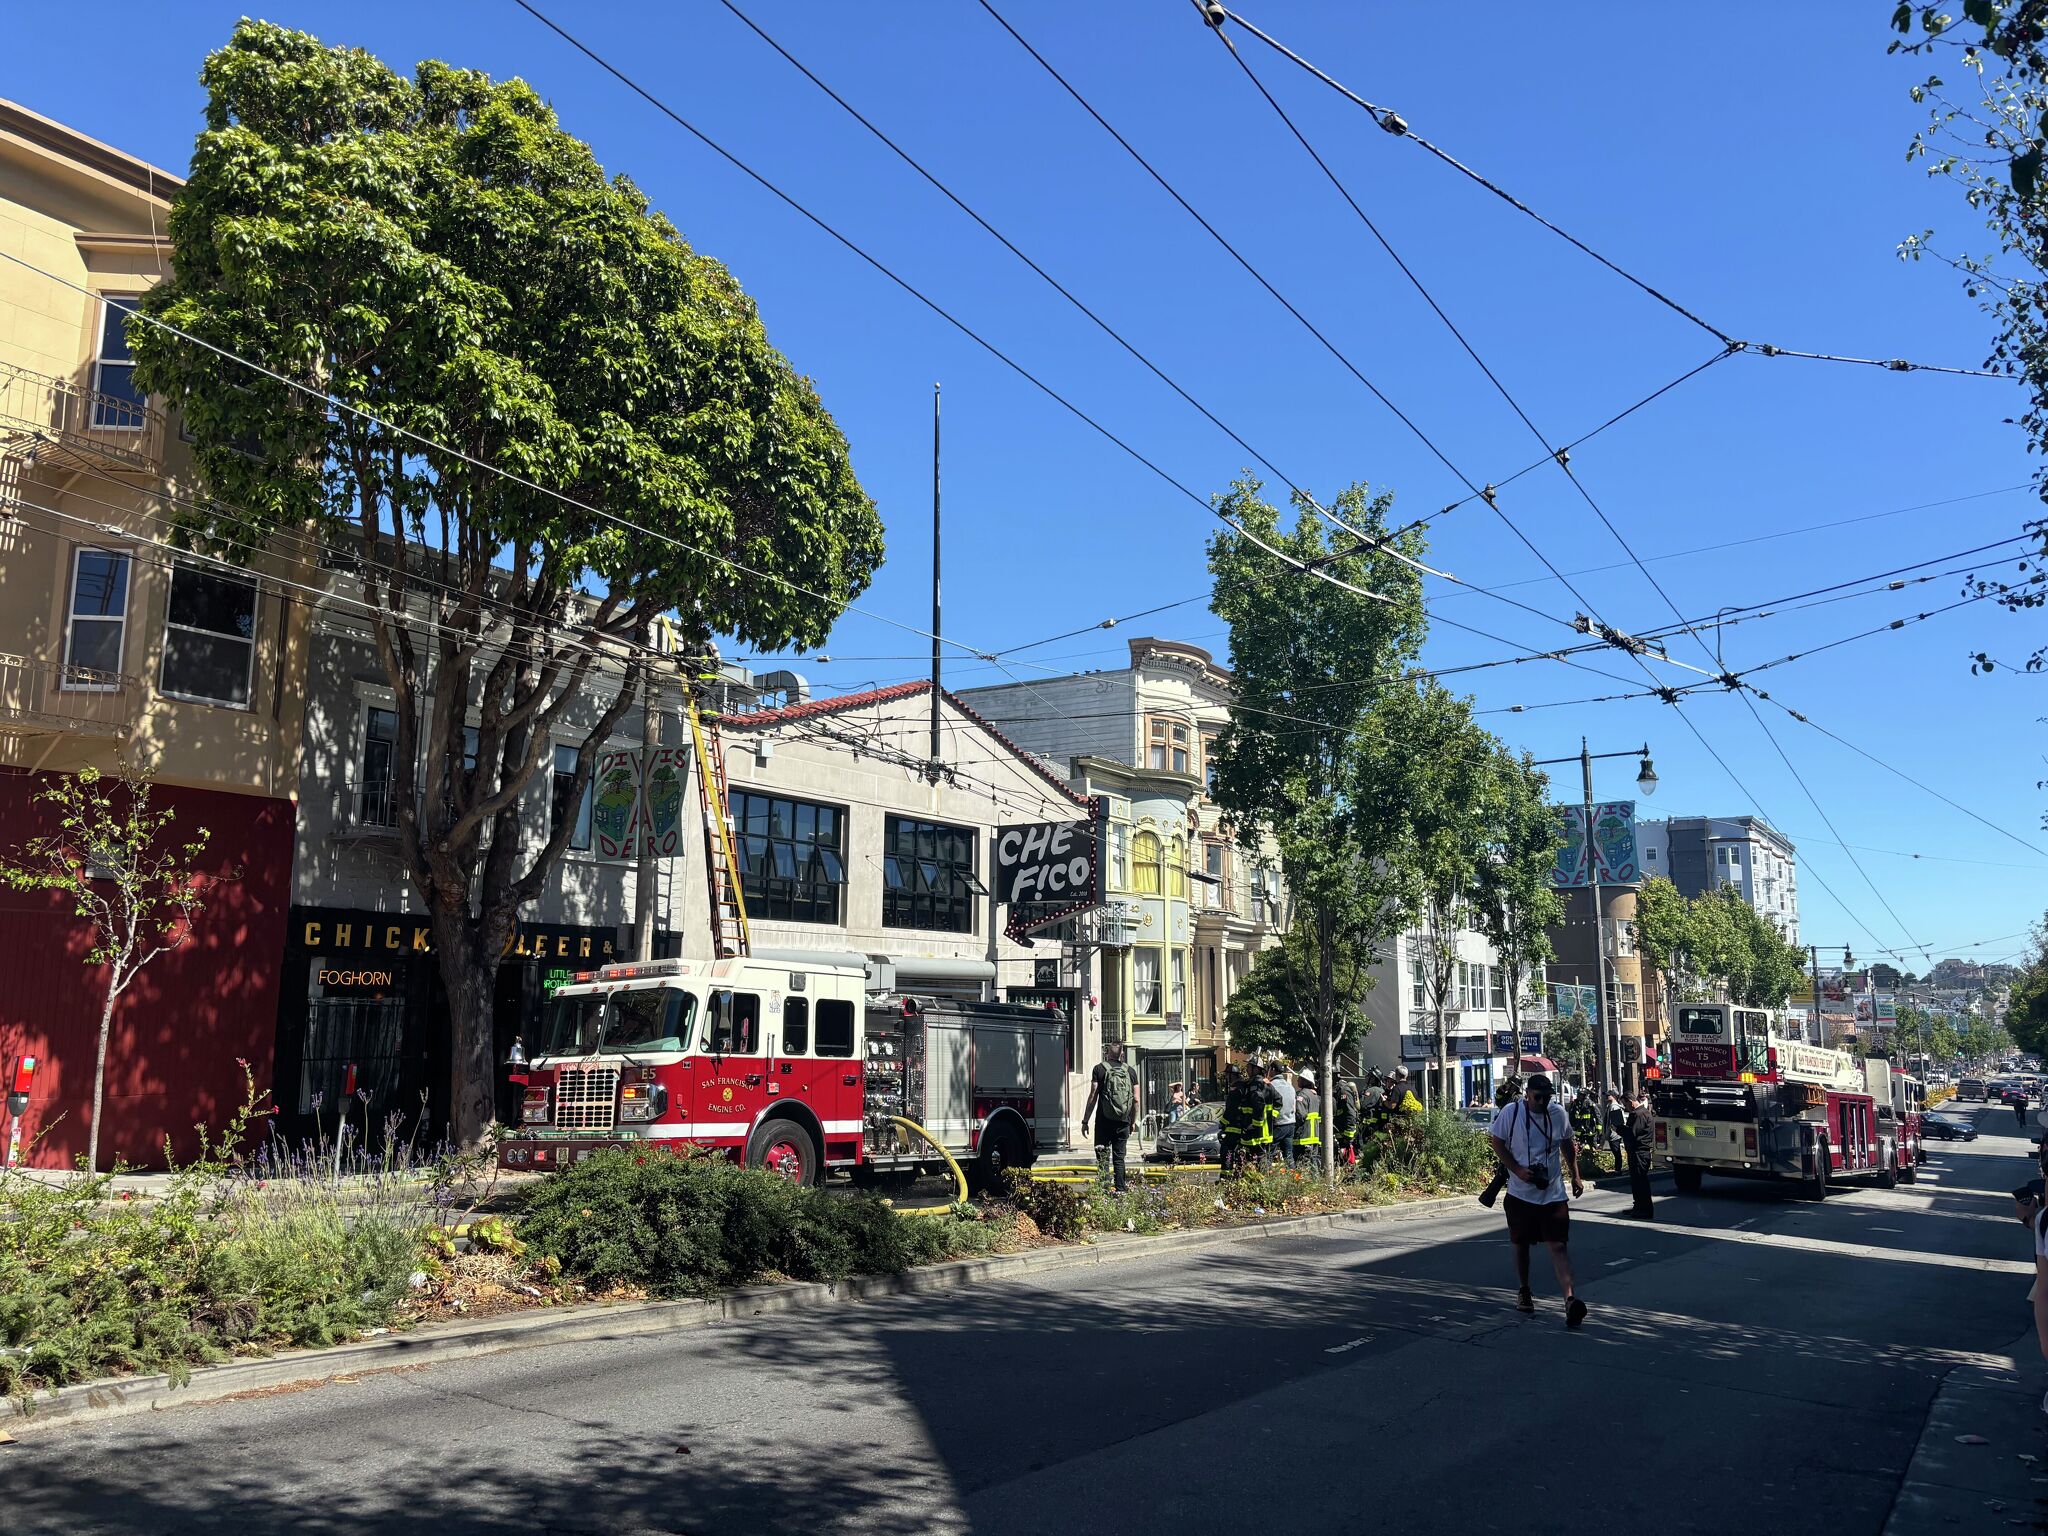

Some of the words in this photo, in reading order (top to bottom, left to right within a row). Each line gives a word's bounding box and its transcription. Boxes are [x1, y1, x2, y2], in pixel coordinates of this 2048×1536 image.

[1560, 804, 1632, 825] IVIS
[600, 831, 677, 858] DERO
[999, 820, 1077, 866] CHE
[1552, 863, 1634, 885] DERO
[603, 940, 613, 954] &
[318, 969, 392, 985] FOGHORN
[1692, 1045, 1727, 1055] FRANCISCO
[1697, 1052, 1709, 1060] T5
[1680, 1058, 1699, 1067] AERIAL
[641, 1068, 656, 1080] E5
[701, 1079, 715, 1089] SAN
[717, 1077, 754, 1091] FRANCISCO
[708, 1103, 733, 1113] ENGINE
